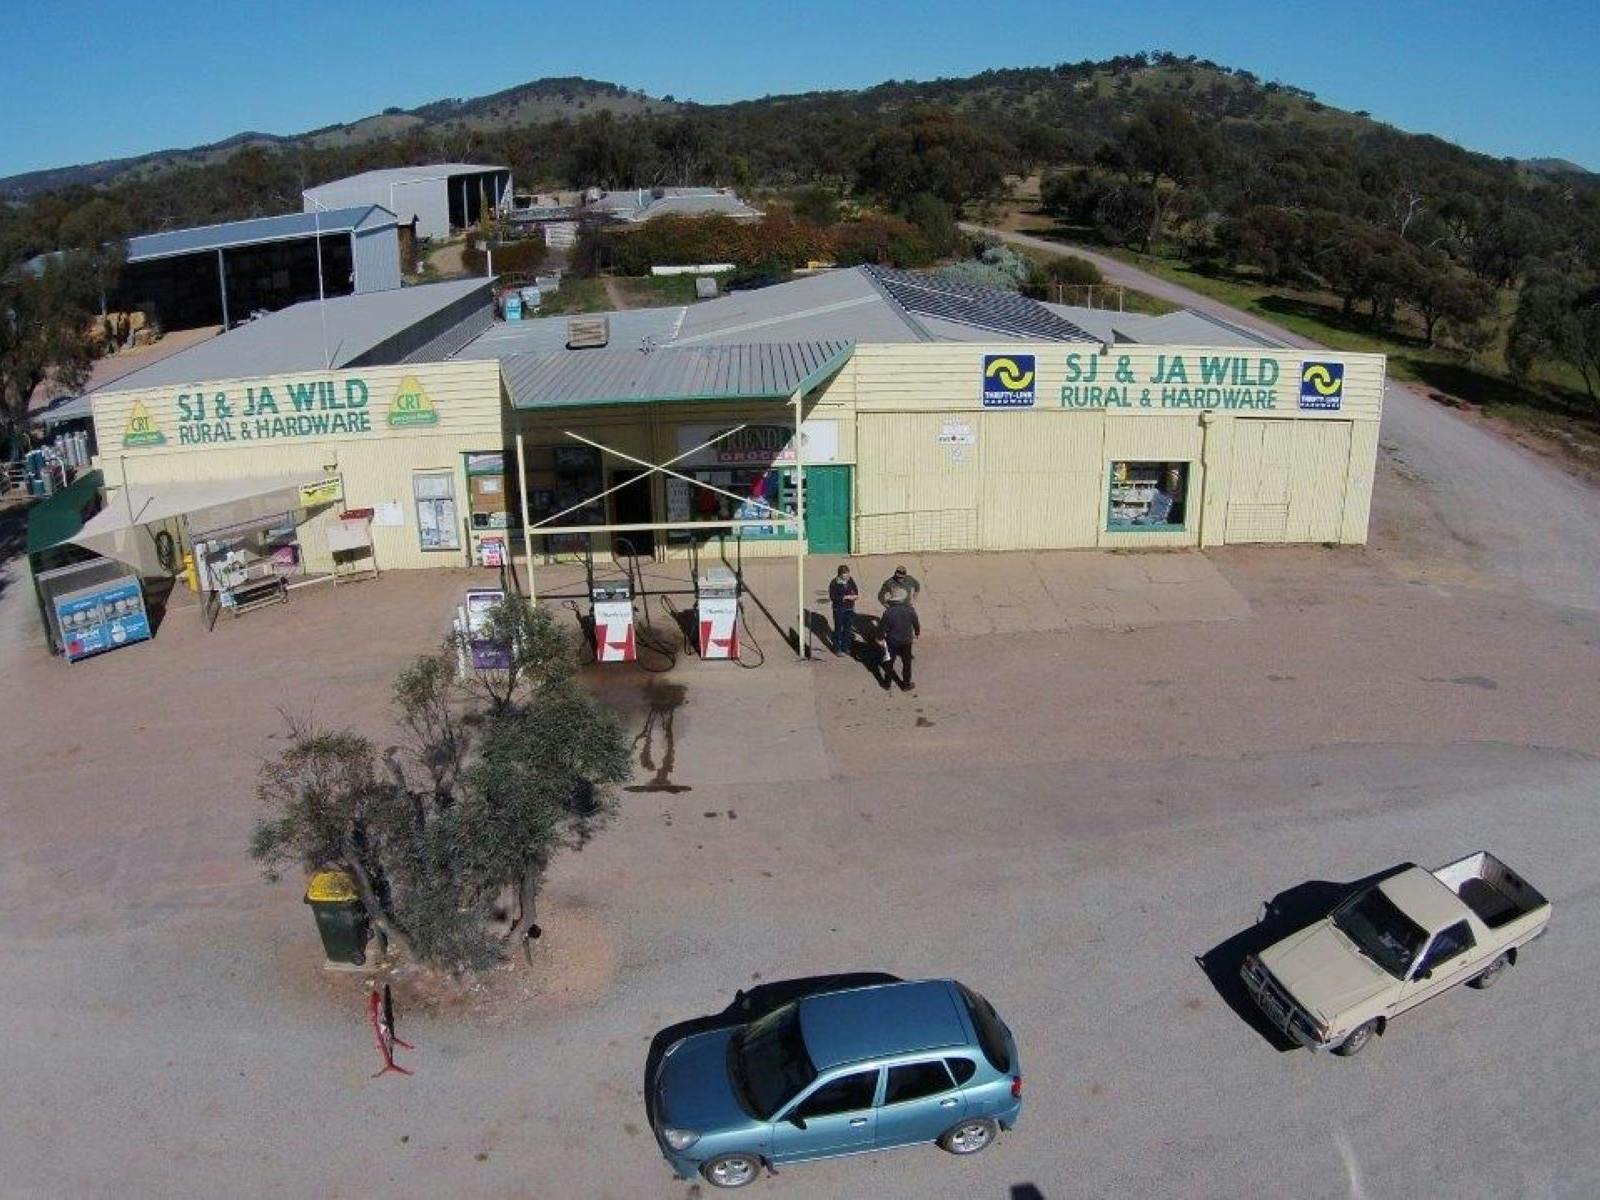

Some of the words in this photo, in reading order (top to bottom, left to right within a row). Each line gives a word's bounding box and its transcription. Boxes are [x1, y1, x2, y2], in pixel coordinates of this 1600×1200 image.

[1066, 353, 1097, 382] SJ
[1115, 354, 1135, 384] &
[1150, 354, 1187, 384] JA
[1200, 356, 1279, 385] WILD
[178, 393, 205, 422] SJ
[215, 391, 232, 418] &
[243, 386, 278, 416] JA
[286, 379, 368, 412] WILD
[397, 393, 422, 411] CRT
[1061, 386, 1132, 408] RURAL
[1140, 388, 1152, 407] &
[1162, 387, 1277, 409] HARDWARE
[131, 416, 149, 432] CRT
[179, 421, 236, 445] RURAL
[241, 421, 252, 440] &
[256, 410, 372, 438] HARDWARE
